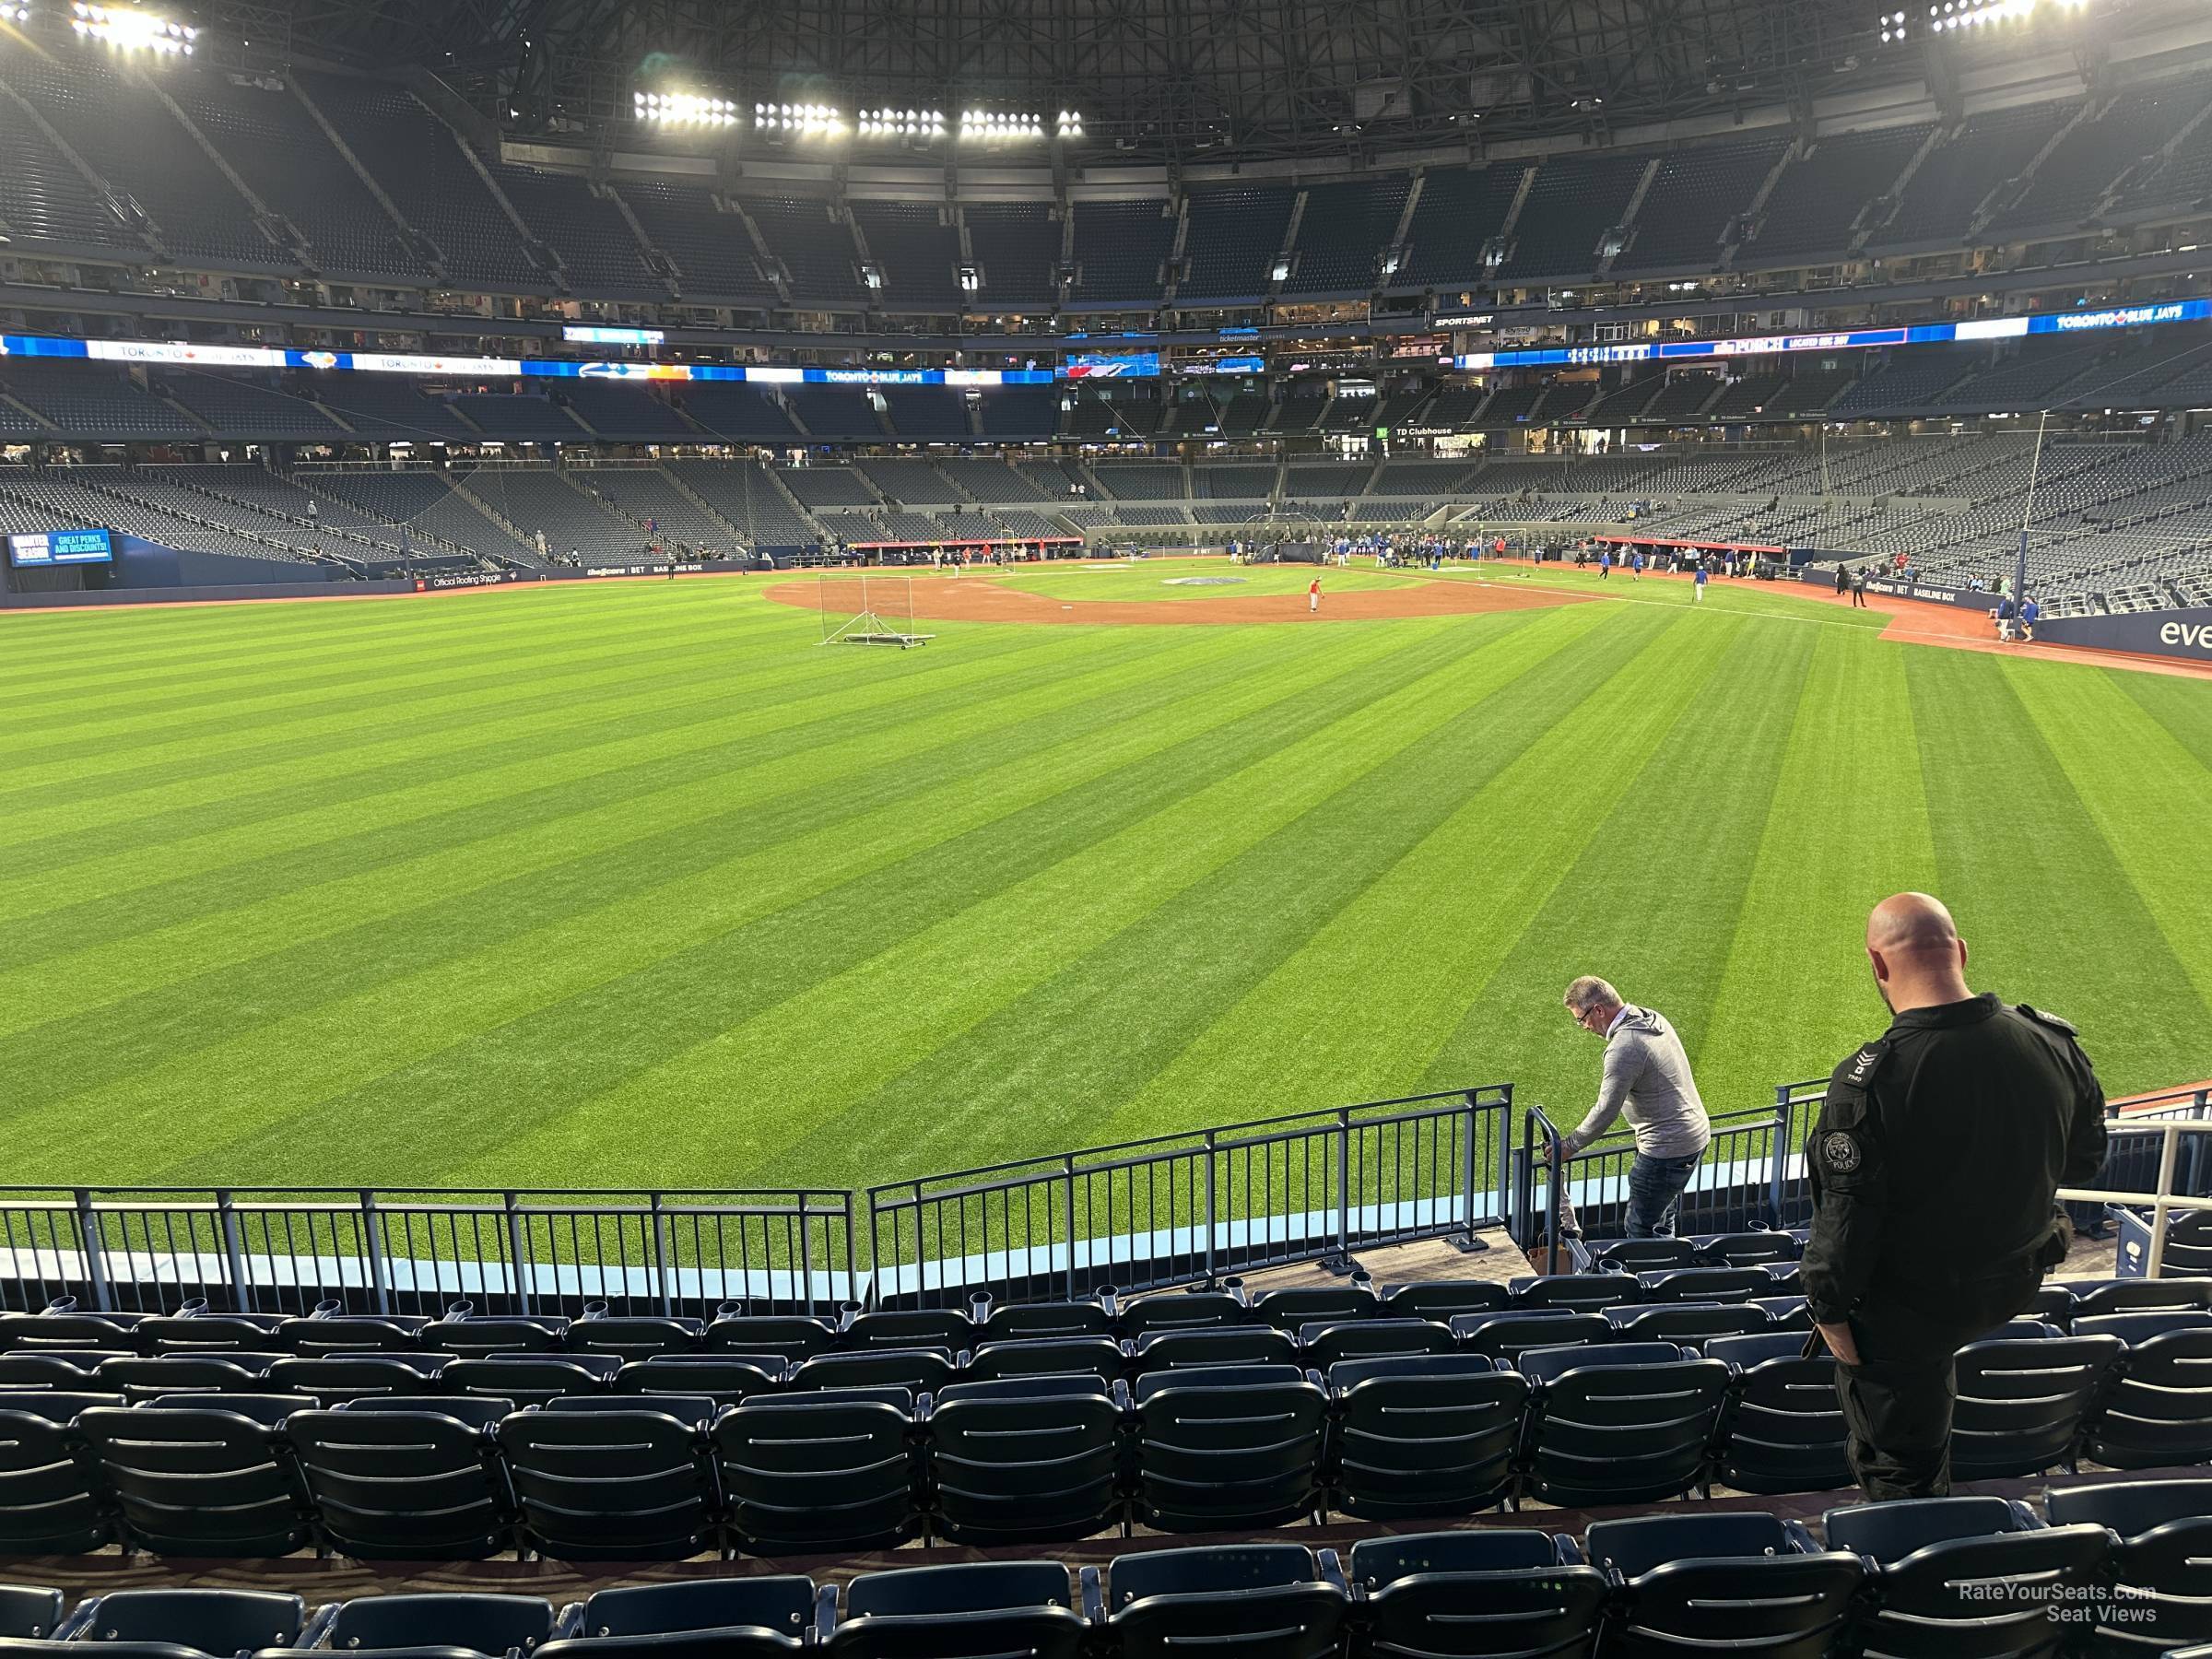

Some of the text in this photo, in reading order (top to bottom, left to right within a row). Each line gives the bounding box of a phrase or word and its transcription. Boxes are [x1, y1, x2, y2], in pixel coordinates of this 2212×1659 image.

[1434, 315, 1494, 326] SPORTSNET
[2057, 305, 2183, 329] TORONTO BLUE JAYS
[825, 371, 868, 382] TORONTO
[877, 371, 900, 382] BLUE
[58, 535, 101, 545] GREAT PERKS
[55, 544, 69, 553] AND
[587, 568, 625, 577] theScore
[434, 577, 456, 587] Official
[456, 575, 480, 585] Roofing
[1865, 581, 1956, 602] theScore BET BASELINE BOX
